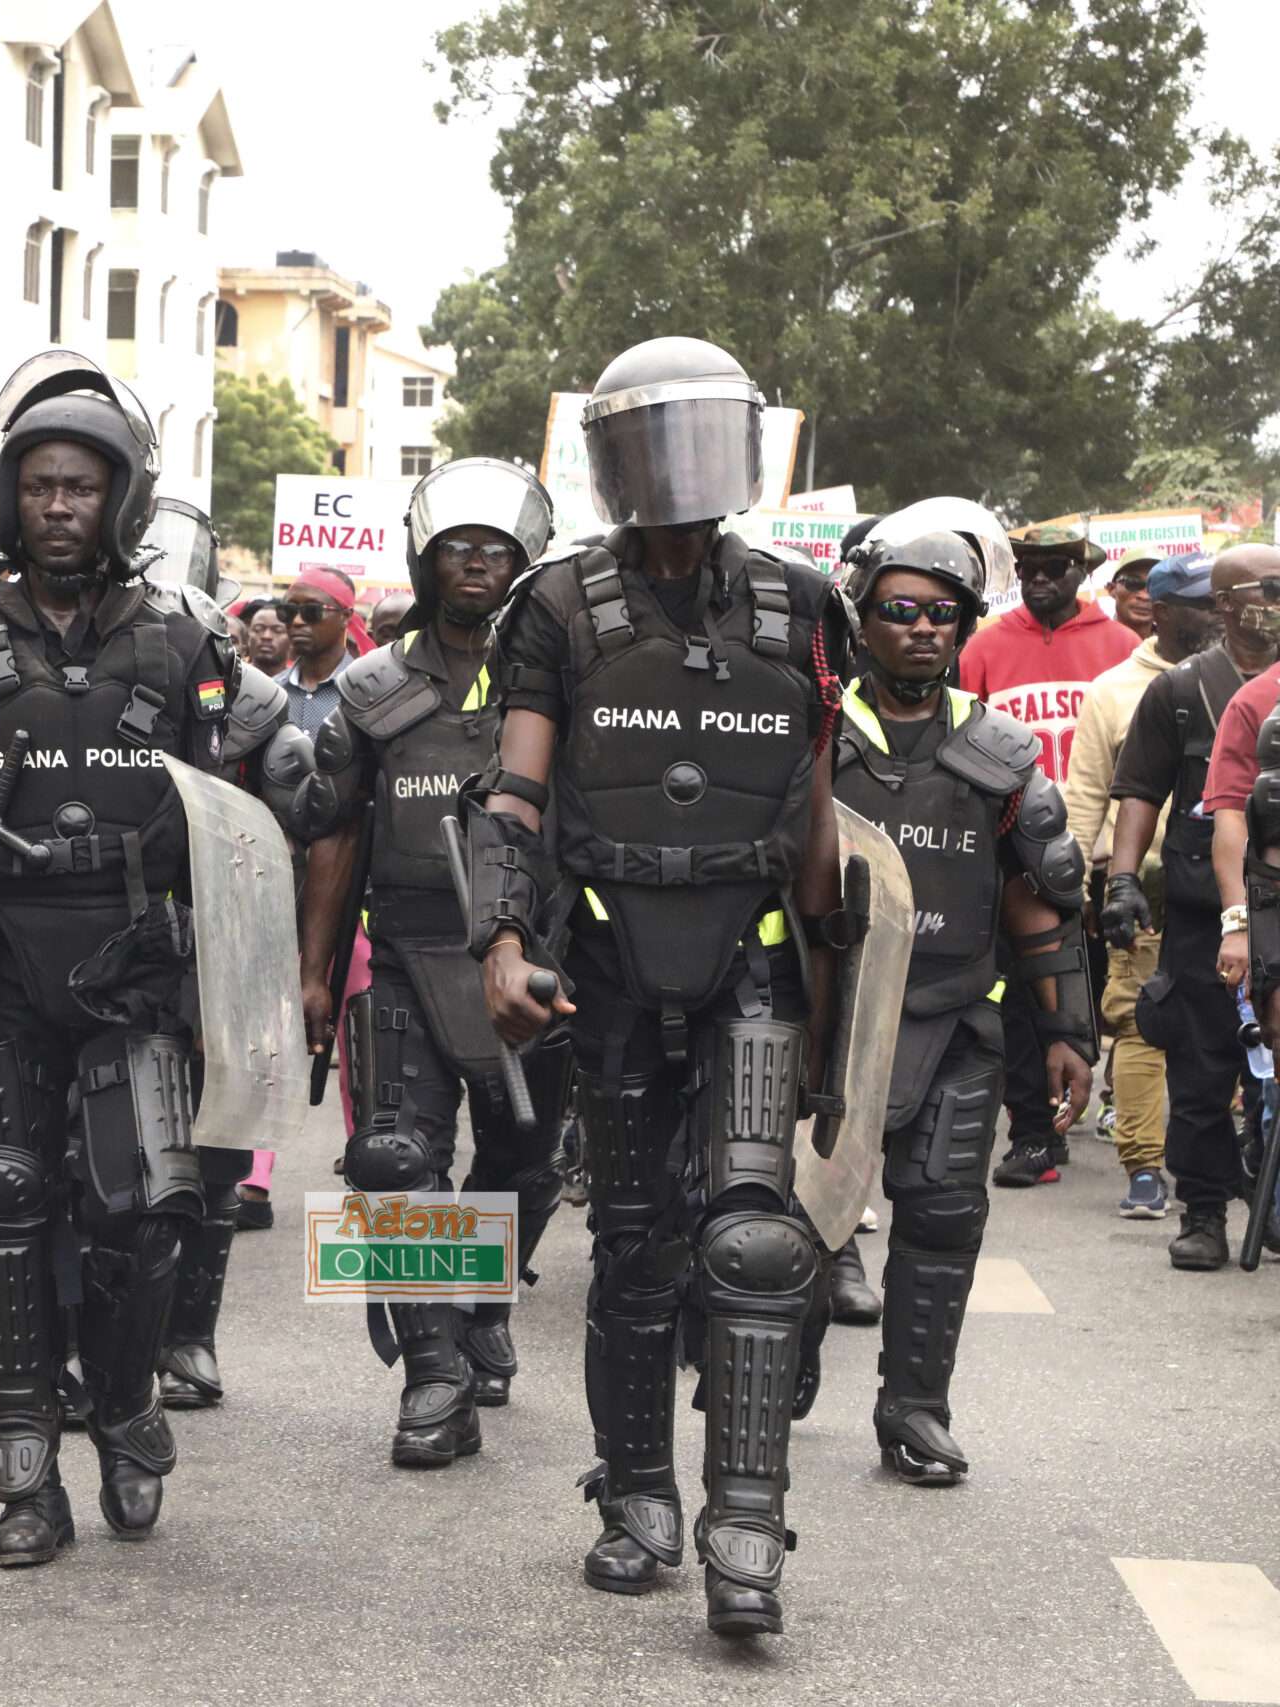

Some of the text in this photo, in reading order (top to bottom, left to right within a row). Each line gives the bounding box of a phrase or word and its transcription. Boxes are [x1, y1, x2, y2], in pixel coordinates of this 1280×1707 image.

[314, 493, 353, 518] EC
[278, 523, 385, 551] BANZA!
[772, 522, 844, 539] IT IS TIME
[1100, 525, 1197, 544] CLEAN REGISTER
[594, 706, 790, 735] GHANA POLICE
[85, 748, 163, 768] POLICE
[395, 773, 460, 798] GHANA
[899, 824, 977, 853] POLIE
